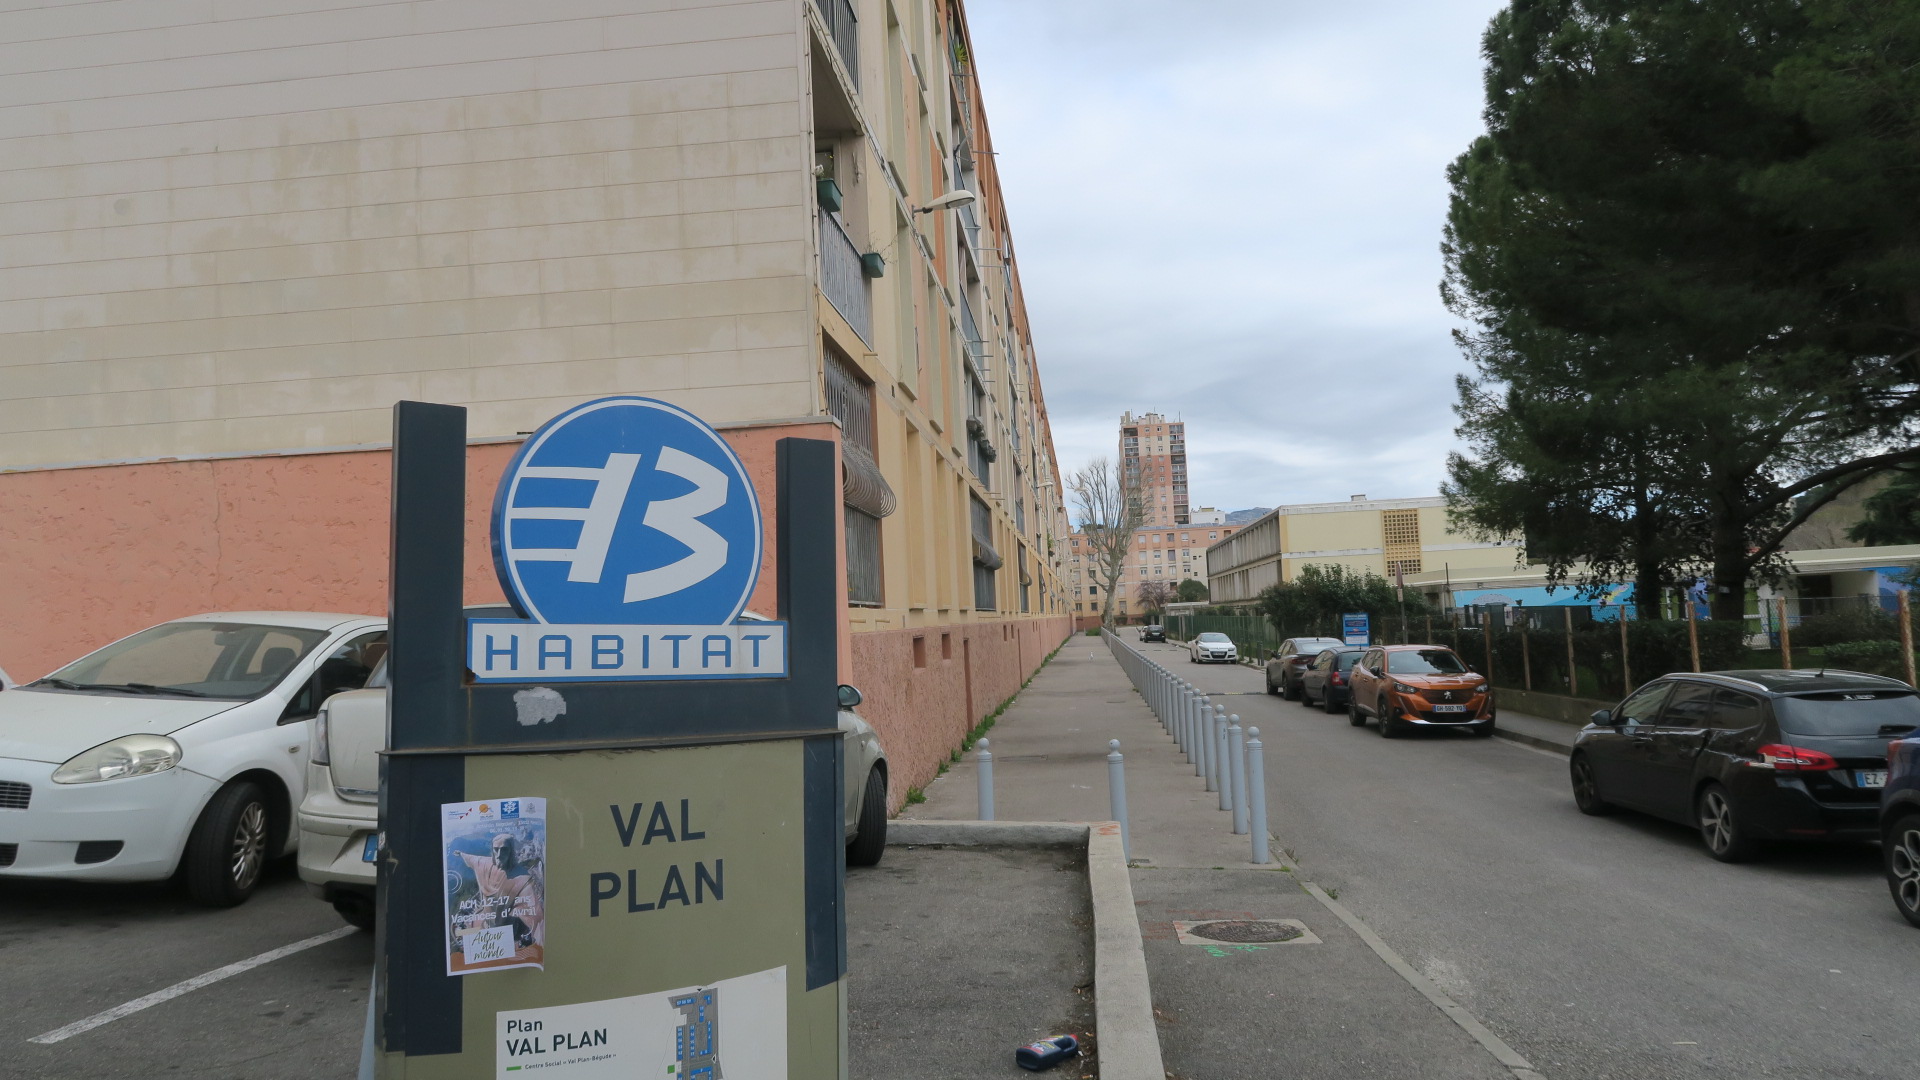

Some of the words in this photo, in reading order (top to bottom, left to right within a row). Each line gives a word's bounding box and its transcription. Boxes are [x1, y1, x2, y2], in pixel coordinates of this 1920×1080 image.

[486, 634, 771, 671] HABITAT
[610, 799, 705, 847] VAL
[590, 859, 723, 918] PLAN
[459, 899, 477, 910] ACM
[481, 896, 510, 907] 12-17
[514, 895, 531, 904] ans
[451, 912, 497, 923] Vacances
[472, 931, 504, 946] Autour
[482, 941, 496, 951] du
[474, 946, 505, 961] monde
[507, 1019, 543, 1034] Plan
[506, 1037, 546, 1057] VAL
[553, 1028, 607, 1052] PLAN
[545, 1060, 562, 1068] Social
[577, 1053, 612, 1064] Plan-Bégude
